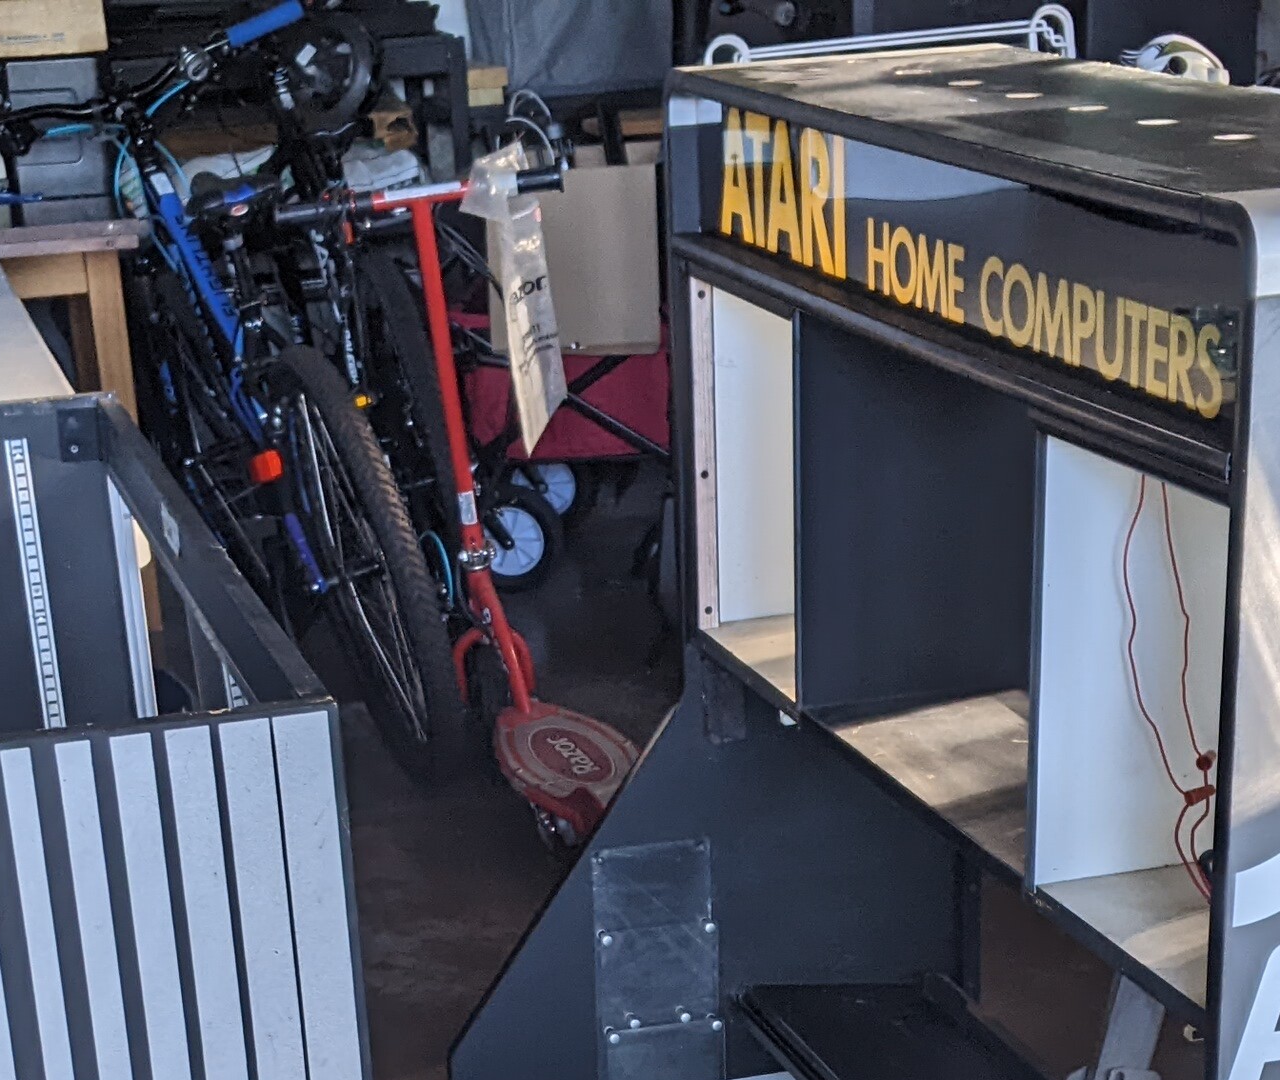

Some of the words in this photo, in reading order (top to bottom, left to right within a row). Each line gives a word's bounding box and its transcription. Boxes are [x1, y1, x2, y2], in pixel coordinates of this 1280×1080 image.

[721, 107, 846, 279] ATARI
[867, 217, 965, 324] HOME
[980, 255, 1224, 419] COMPUTERS
